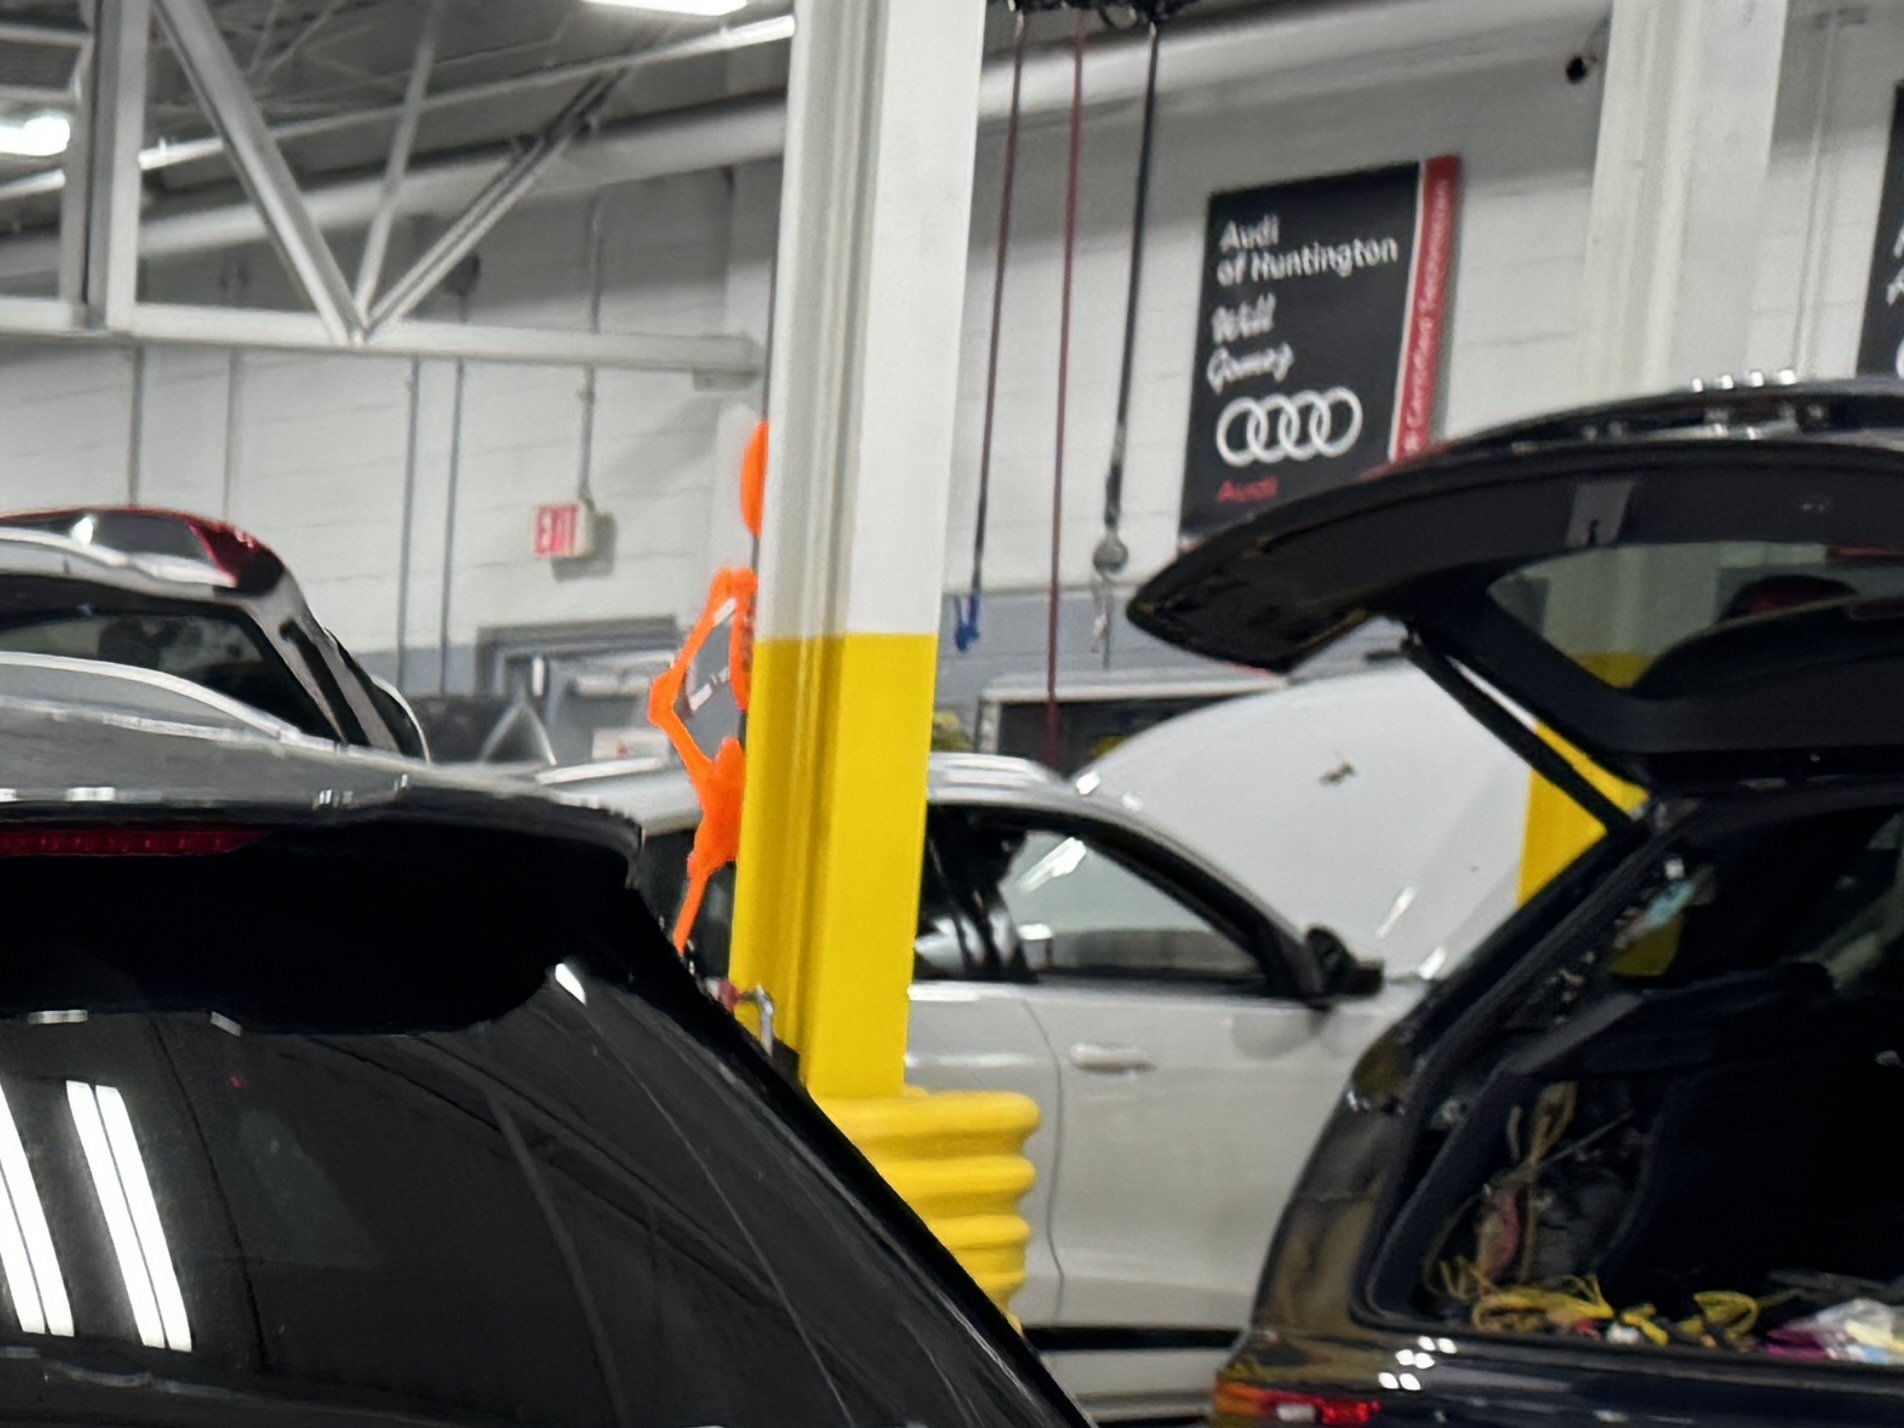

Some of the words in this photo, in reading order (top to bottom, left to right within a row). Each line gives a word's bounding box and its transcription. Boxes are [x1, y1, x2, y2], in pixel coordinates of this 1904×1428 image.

[1219, 214, 1280, 253] Audi
[1216, 252, 1248, 287] of
[1251, 236, 1399, 282] Huntington
